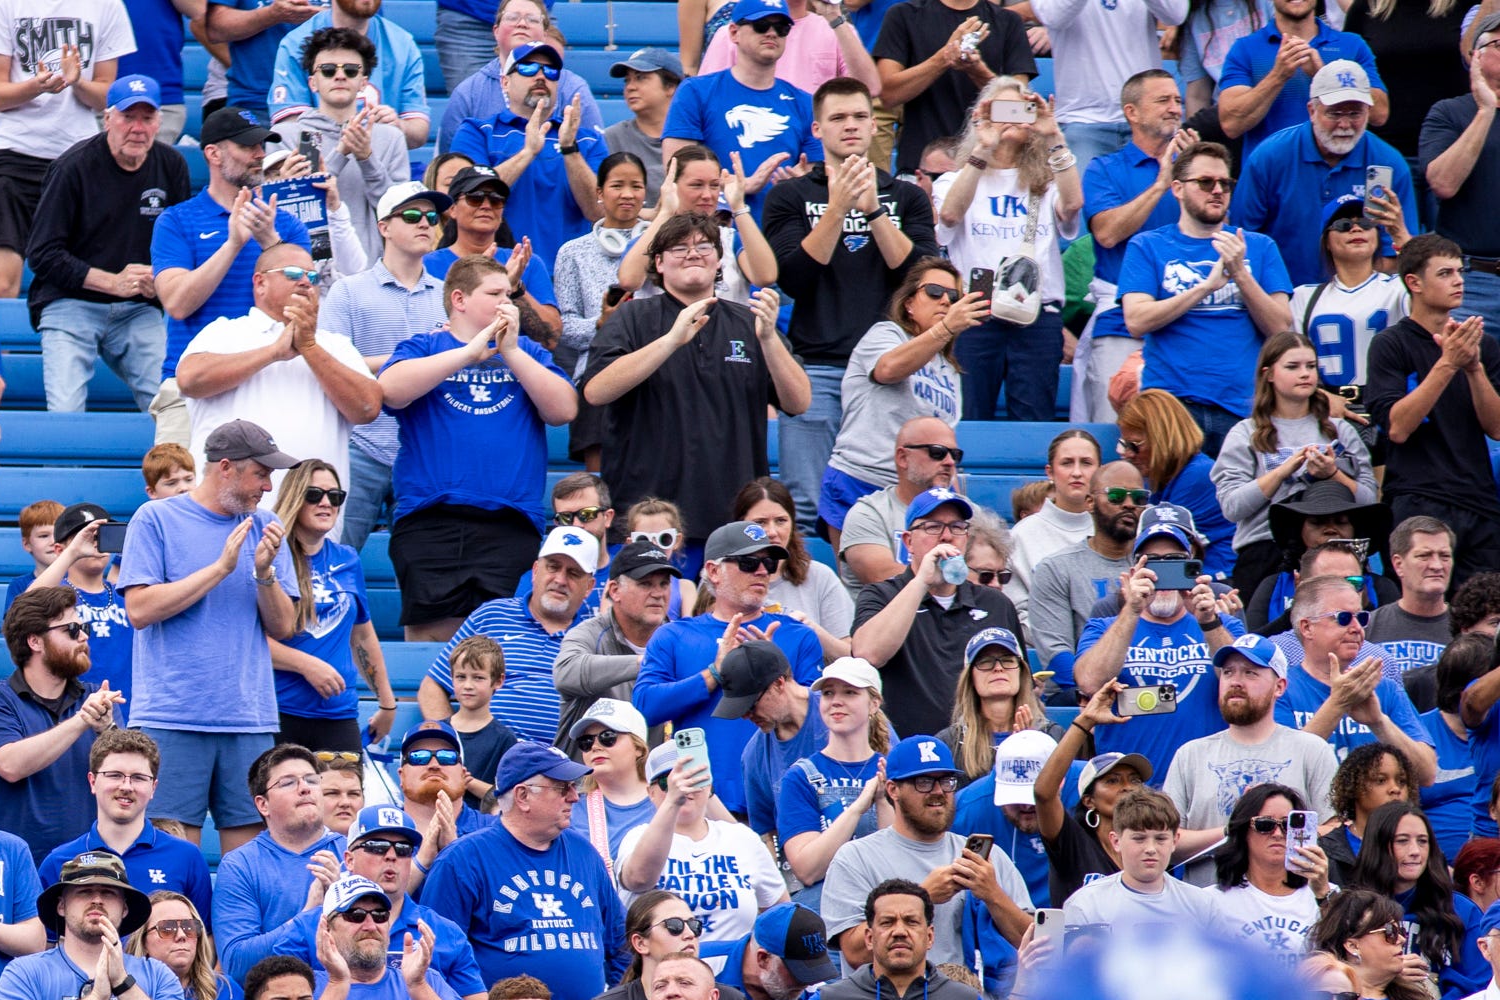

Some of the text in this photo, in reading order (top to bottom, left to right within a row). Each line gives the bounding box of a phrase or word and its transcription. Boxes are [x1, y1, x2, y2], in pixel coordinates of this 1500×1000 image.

[14, 17, 94, 70] SMITH
[1336, 72, 1357, 88] UK
[988, 194, 1028, 218] UK
[729, 340, 745, 358] E
[443, 392, 515, 415] WILDCAT BASKETBALL
[469, 385, 493, 403] UK
[91, 621, 110, 637] UK
[1125, 642, 1212, 663] KENTUCKY
[1129, 664, 1208, 677] WILDCATS
[917, 741, 940, 763] K
[1001, 758, 1042, 771] WILDCATS
[382, 811, 401, 826] UK
[701, 855, 739, 875] THE
[148, 868, 167, 884] UK
[737, 873, 755, 893] IS
[492, 869, 595, 914] KENTUCKY
[532, 893, 567, 918] UK
[531, 918, 575, 929] KENTUCKY
[1265, 931, 1291, 951] UK
